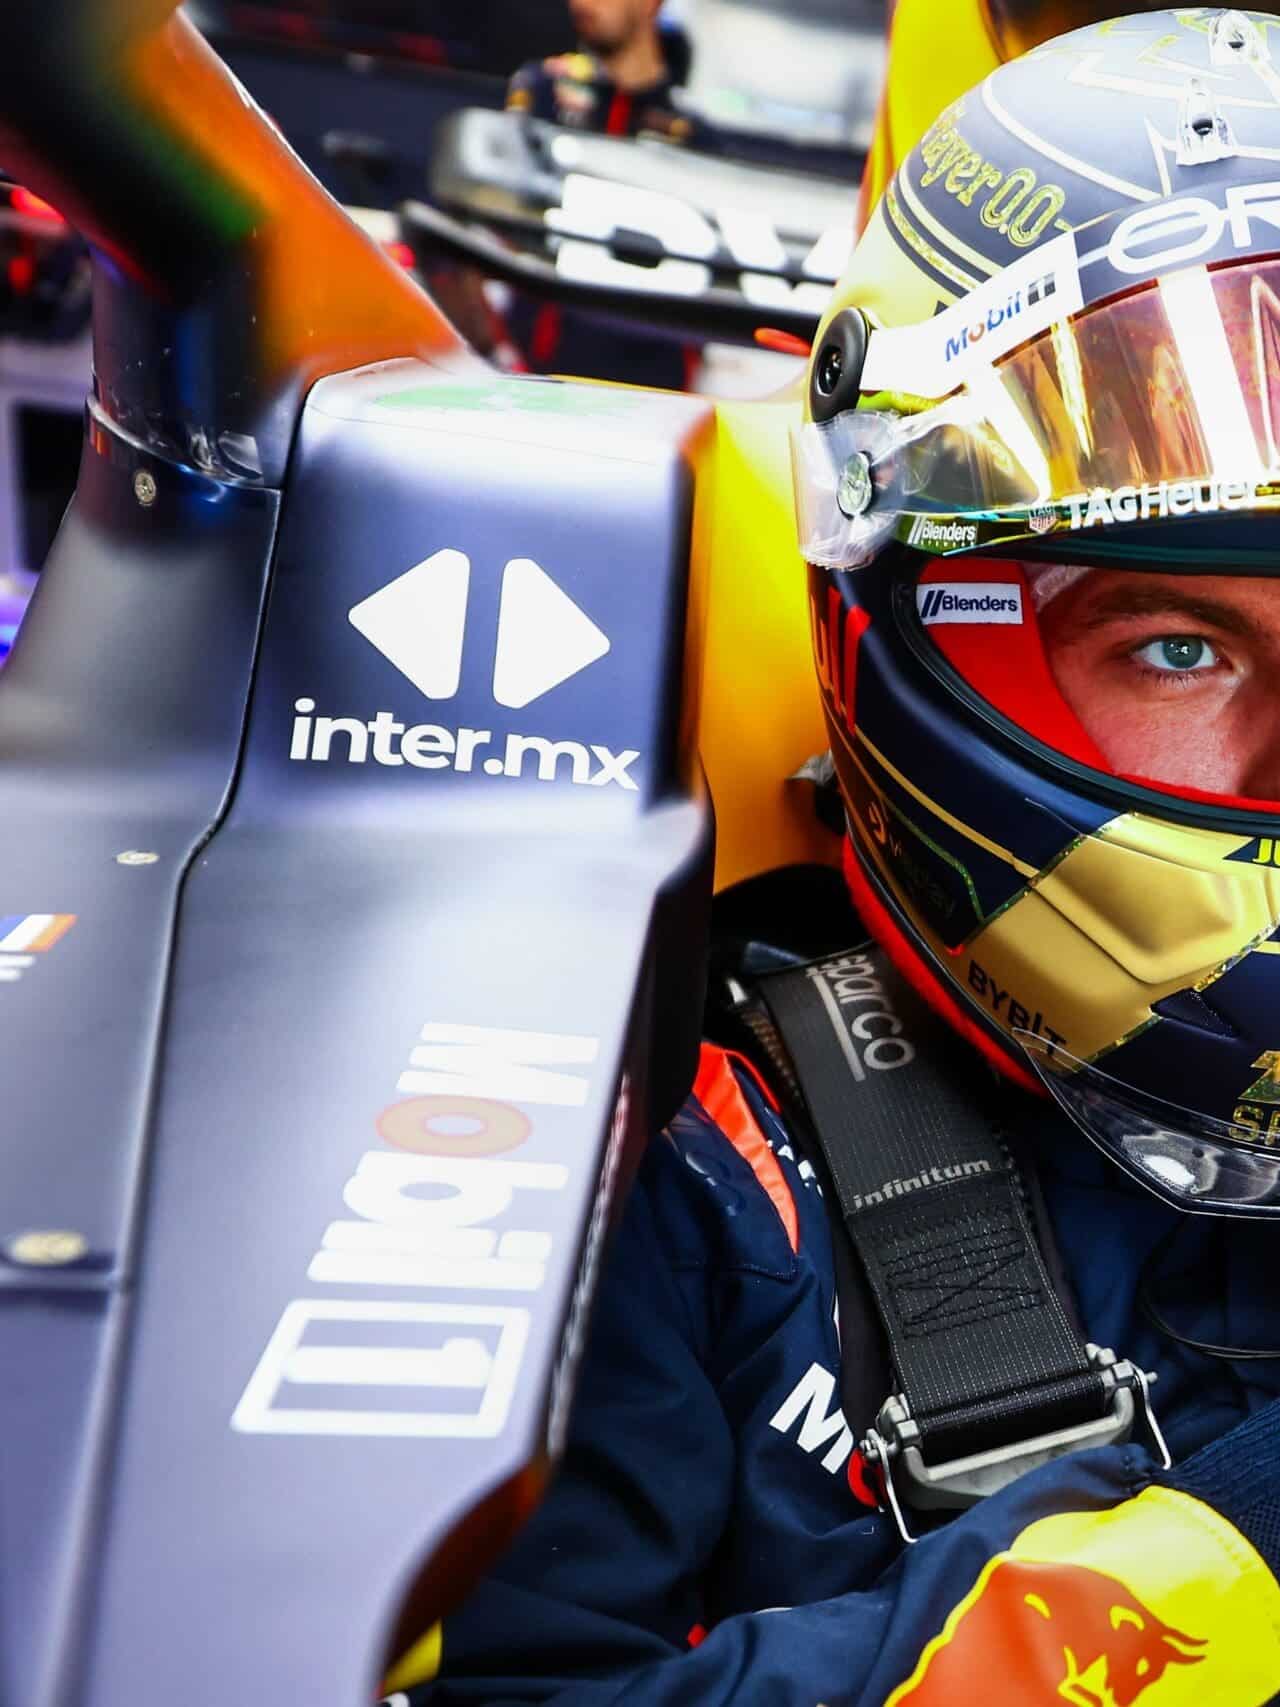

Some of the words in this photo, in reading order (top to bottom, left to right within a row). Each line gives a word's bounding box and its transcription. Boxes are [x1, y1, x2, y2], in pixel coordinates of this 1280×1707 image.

[945, 291, 1021, 362] Mobil
[922, 520, 976, 541] Blenders
[943, 594, 1018, 612] Blenders
[290, 698, 642, 792] inter.mx
[968, 960, 1066, 1056] BYBIT
[307, 1022, 599, 1291] Mobil
[853, 1159, 993, 1210] infinitum
